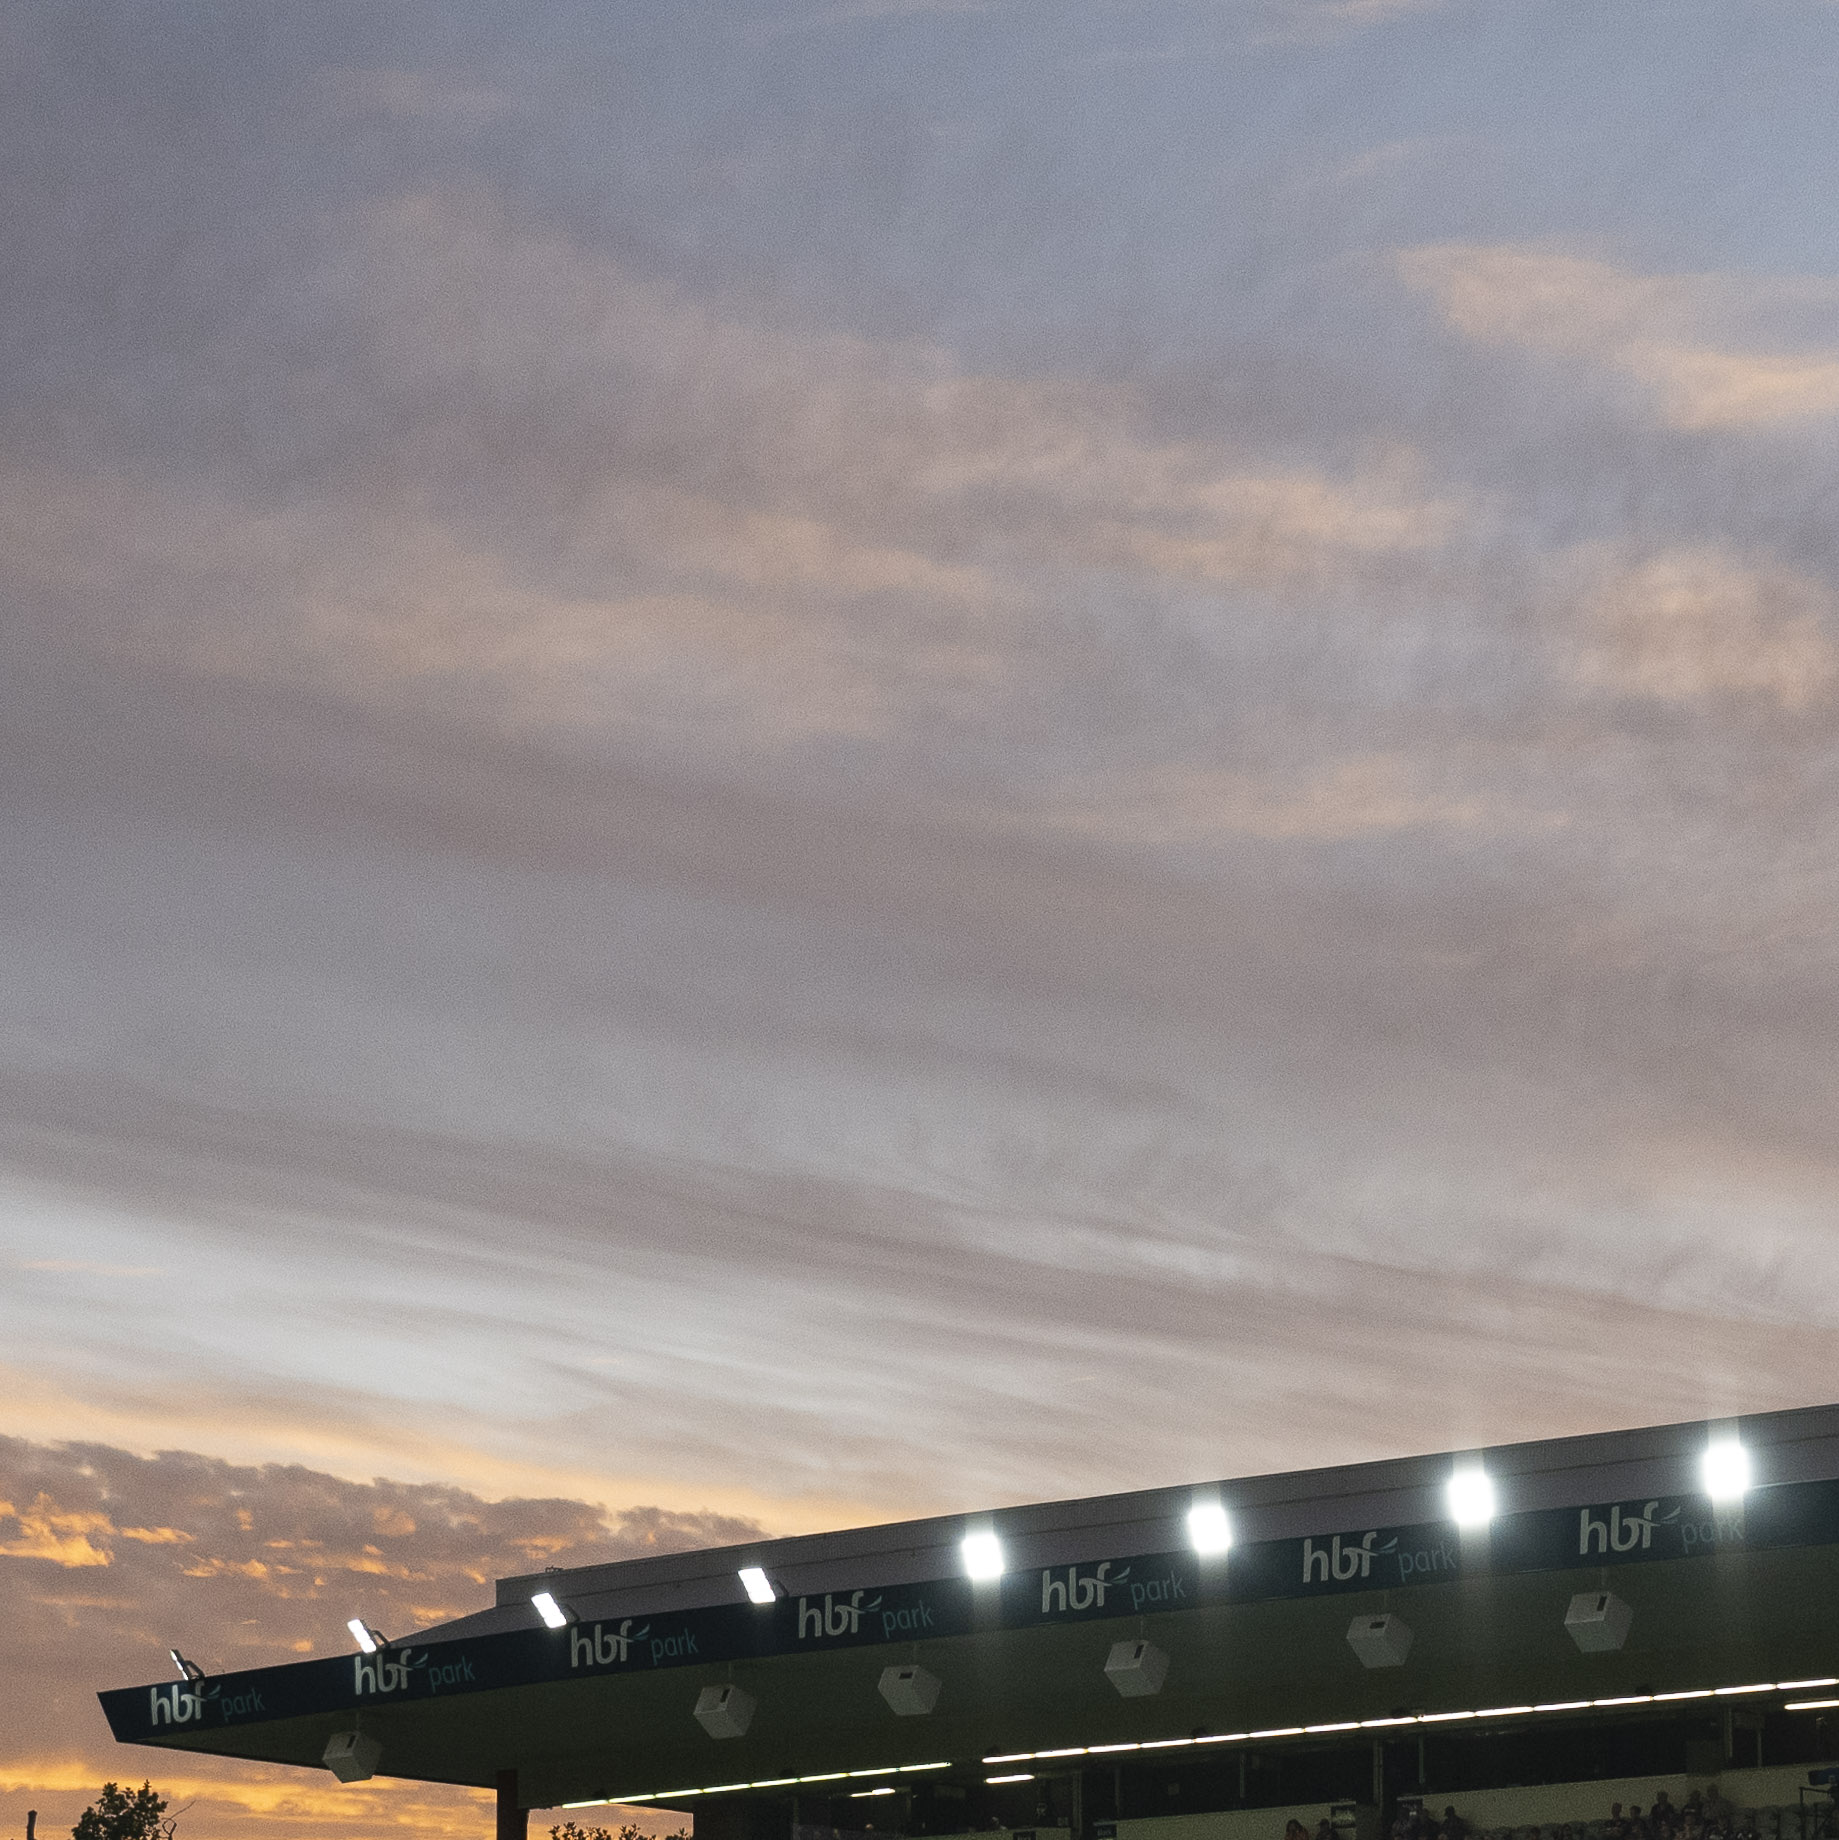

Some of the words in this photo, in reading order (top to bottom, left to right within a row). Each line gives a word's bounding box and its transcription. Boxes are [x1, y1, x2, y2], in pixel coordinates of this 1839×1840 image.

[1579, 1501, 1661, 1555] hbf
[1303, 1532, 1379, 1583] hbf
[1398, 1541, 1457, 1583] park
[1042, 1562, 1112, 1612] hbf
[1130, 1571, 1186, 1610] park
[798, 1591, 867, 1639] hbf
[882, 1601, 934, 1638] park
[570, 1620, 635, 1667] hbf
[651, 1629, 699, 1665] park
[355, 1649, 415, 1695] hbf
[429, 1656, 476, 1691] park
[150, 1681, 207, 1725] hbf
[221, 1689, 266, 1720] park
